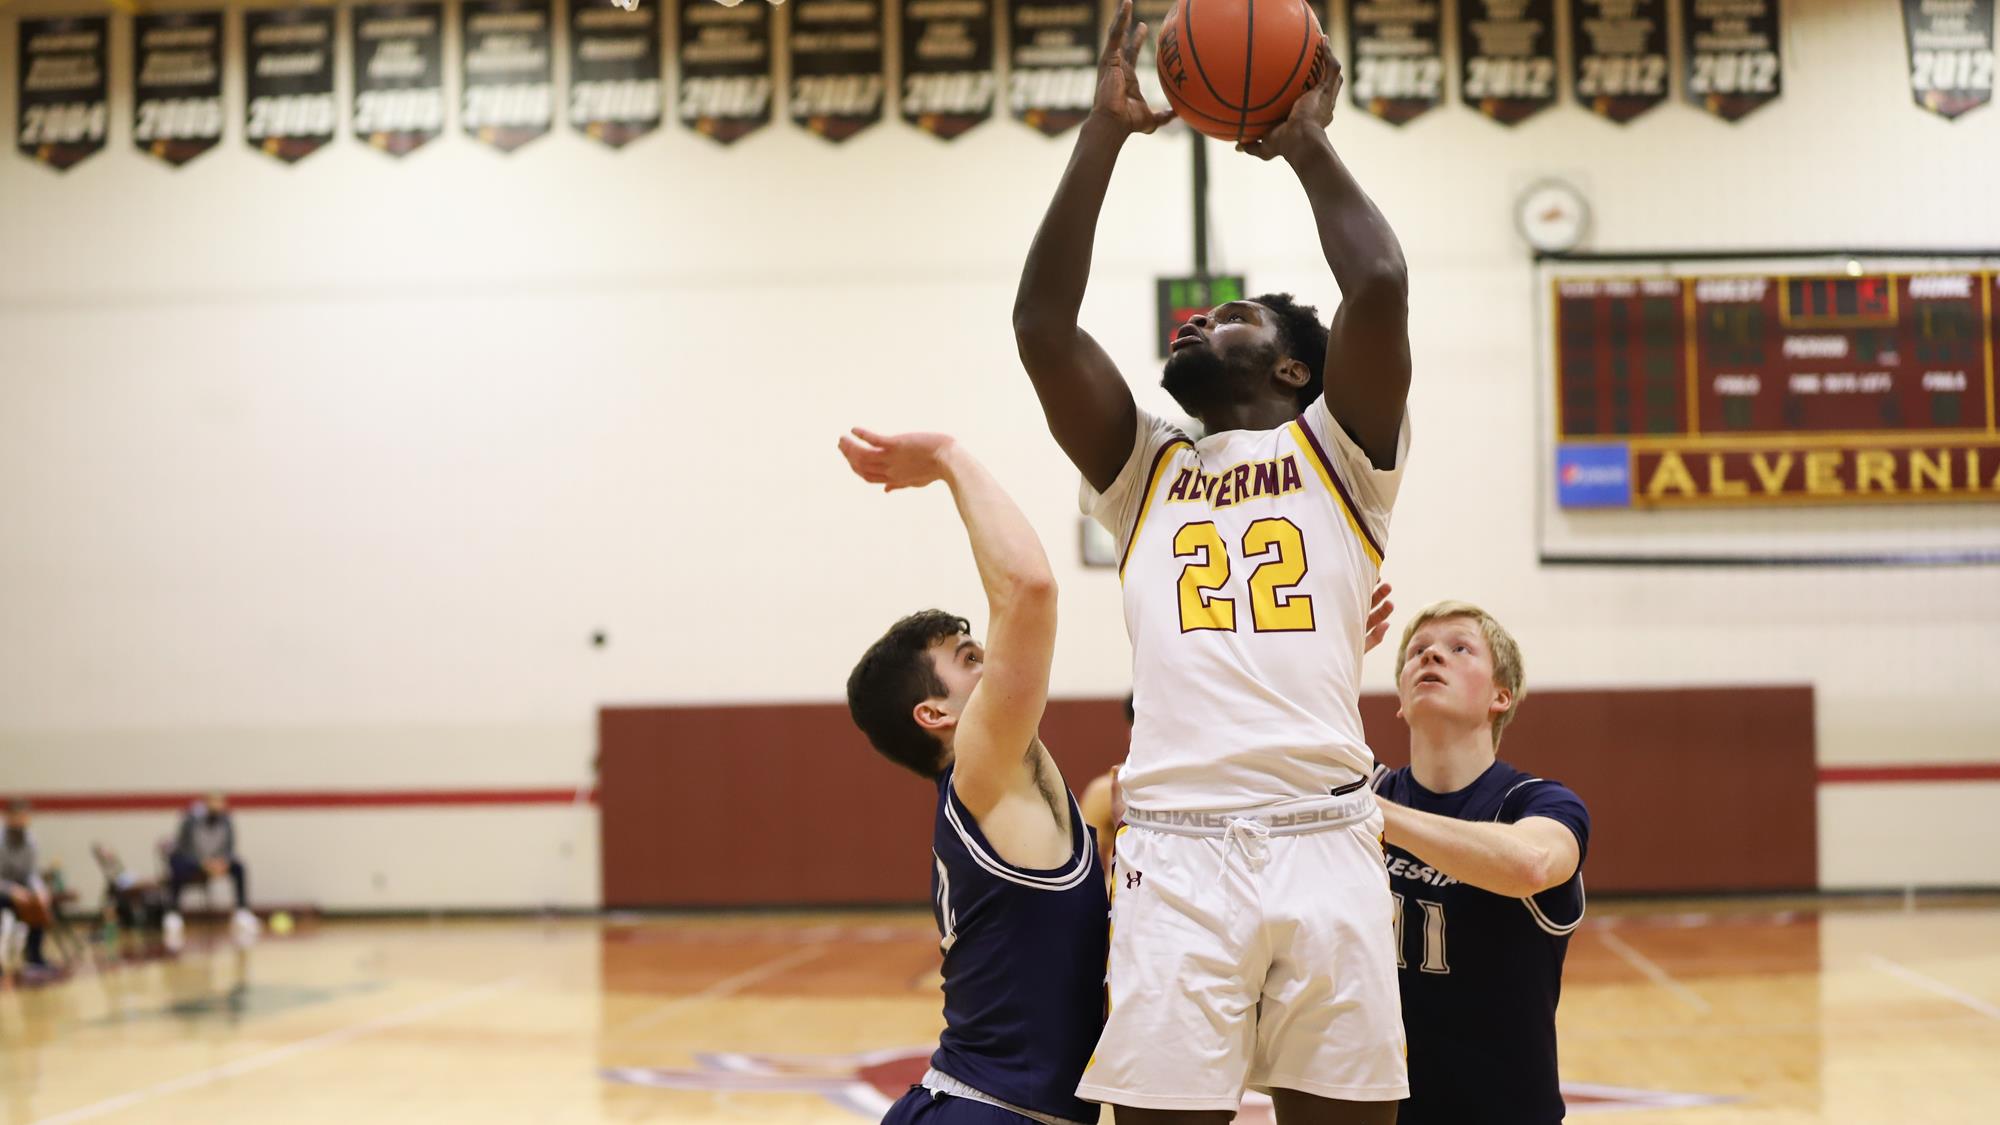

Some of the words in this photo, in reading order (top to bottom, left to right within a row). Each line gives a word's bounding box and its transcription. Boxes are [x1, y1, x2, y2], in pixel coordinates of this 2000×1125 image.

[1354, 56, 1441, 99] 2012
[1464, 55, 1553, 98] 2012
[1578, 55, 1666, 95] 2012
[1689, 51, 1777, 94] 2012
[1912, 50, 1993, 90] 2012
[679, 75, 770, 118] 2007
[790, 74, 882, 116] 2007
[903, 71, 993, 112] 2007
[20, 103, 106, 144] 2004
[1173, 516, 1316, 634] 22
